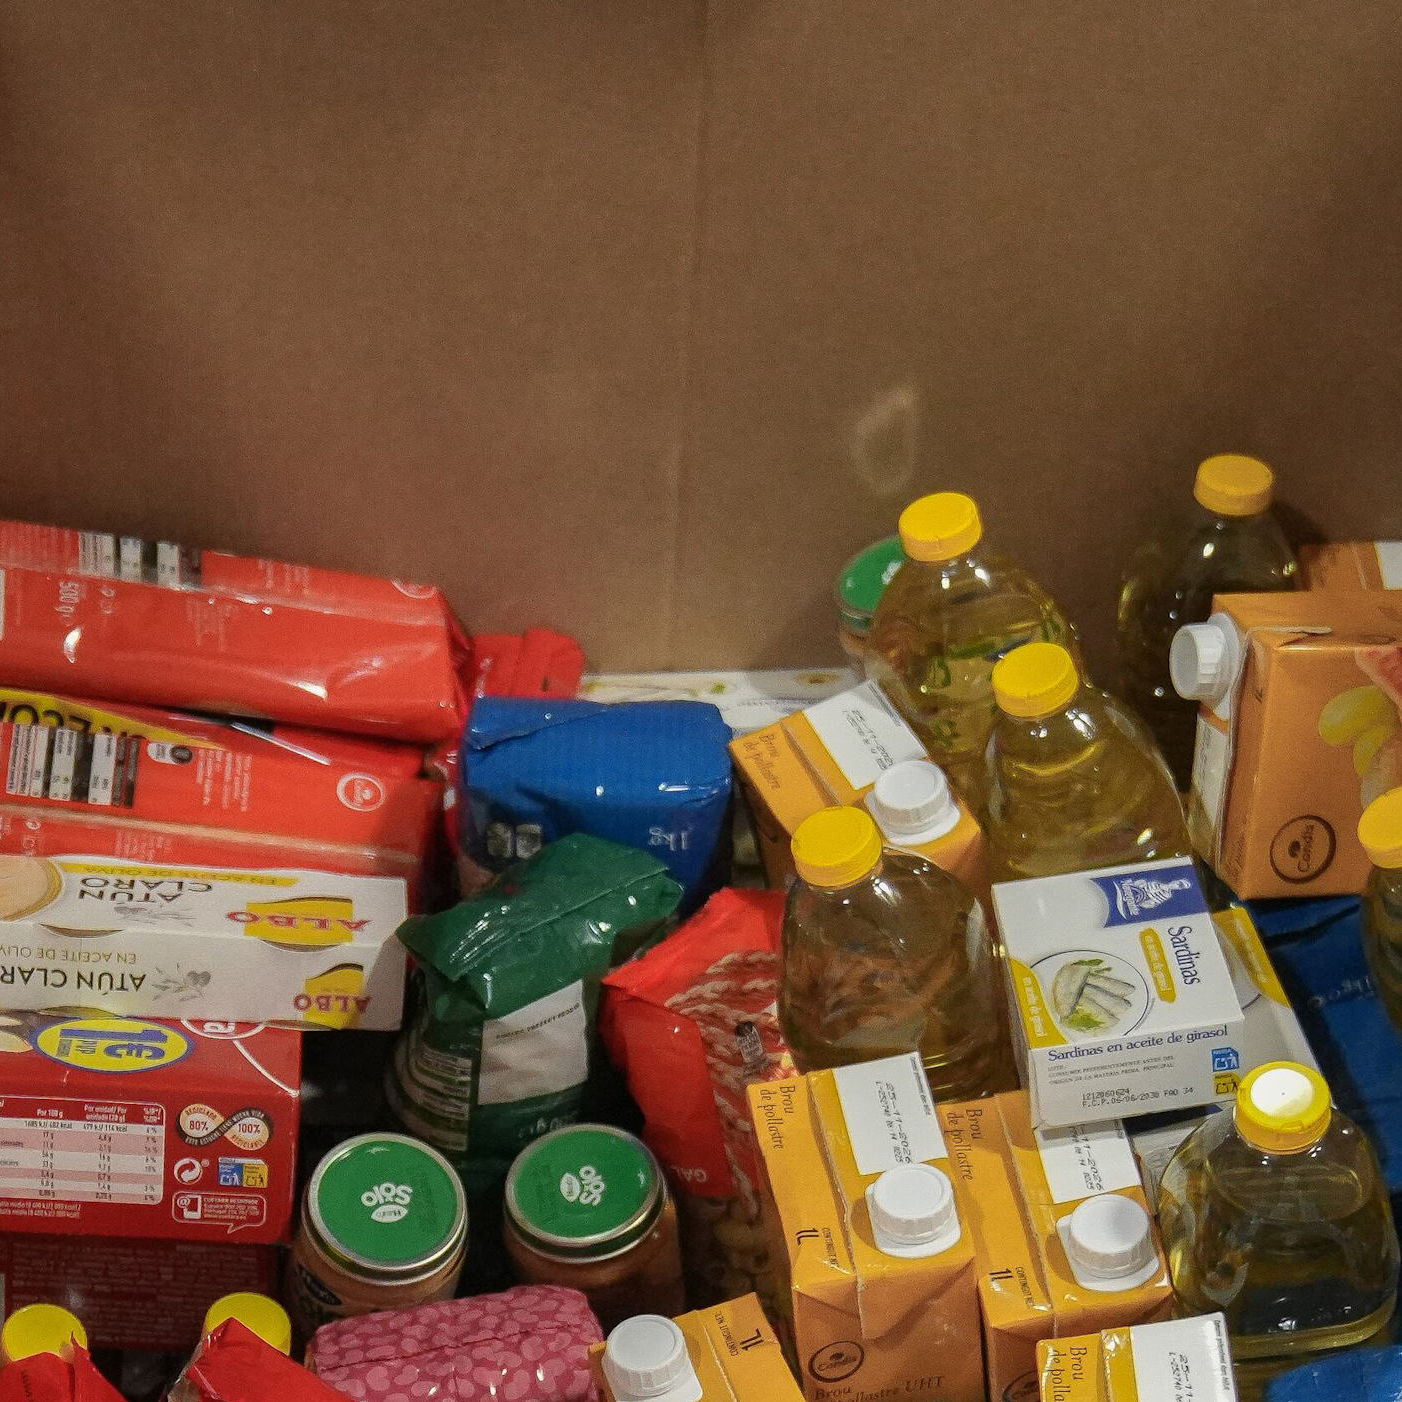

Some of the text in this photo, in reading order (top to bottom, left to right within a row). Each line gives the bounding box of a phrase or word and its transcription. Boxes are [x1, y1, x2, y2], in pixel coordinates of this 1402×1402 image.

[81, 877, 213, 893] CLARO
[226, 910, 372, 932] ALBO
[37, 948, 56, 960] DE
[61, 949, 110, 964] ACEITE
[117, 952, 137, 965] EN
[1167, 926, 1201, 985] Sardinas
[77, 969, 147, 994] ATÚN
[295, 994, 373, 1015] ALBO
[1048, 1026, 1228, 1062] Sardinas en aceite de girasol
[779, 1085, 797, 1115] Brou
[189, 1120, 209, 1131] 80%
[238, 1123, 260, 1135] 100%
[756, 1089, 786, 1150] de pollastre
[965, 1109, 984, 1140] Brou
[944, 1112, 976, 1181] de pollastre
[795, 1227, 821, 1247] 1L
[721, 1325, 740, 1358] CONTINGUT
[739, 1328, 764, 1352] 1L
[1051, 1349, 1066, 1365] de
[1069, 1346, 1088, 1381] Brou
